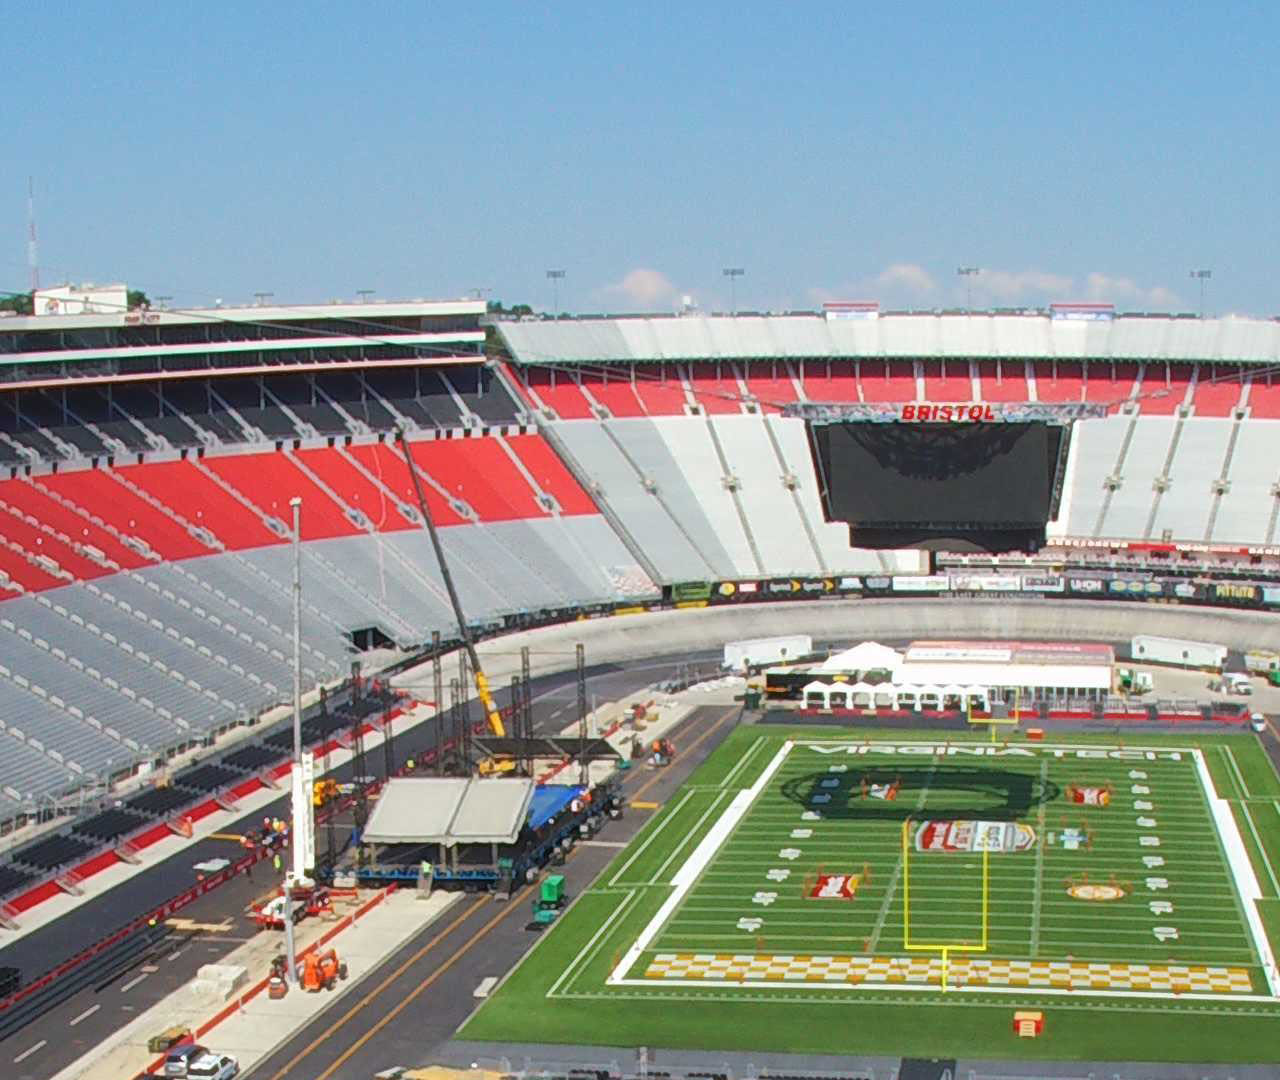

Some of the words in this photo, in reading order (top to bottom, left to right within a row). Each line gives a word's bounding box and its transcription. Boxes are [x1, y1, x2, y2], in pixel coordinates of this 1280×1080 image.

[901, 404, 995, 421] BRISTOL
[808, 744, 1037, 757] VIRGINIA
[1042, 748, 1183, 761] TECH
